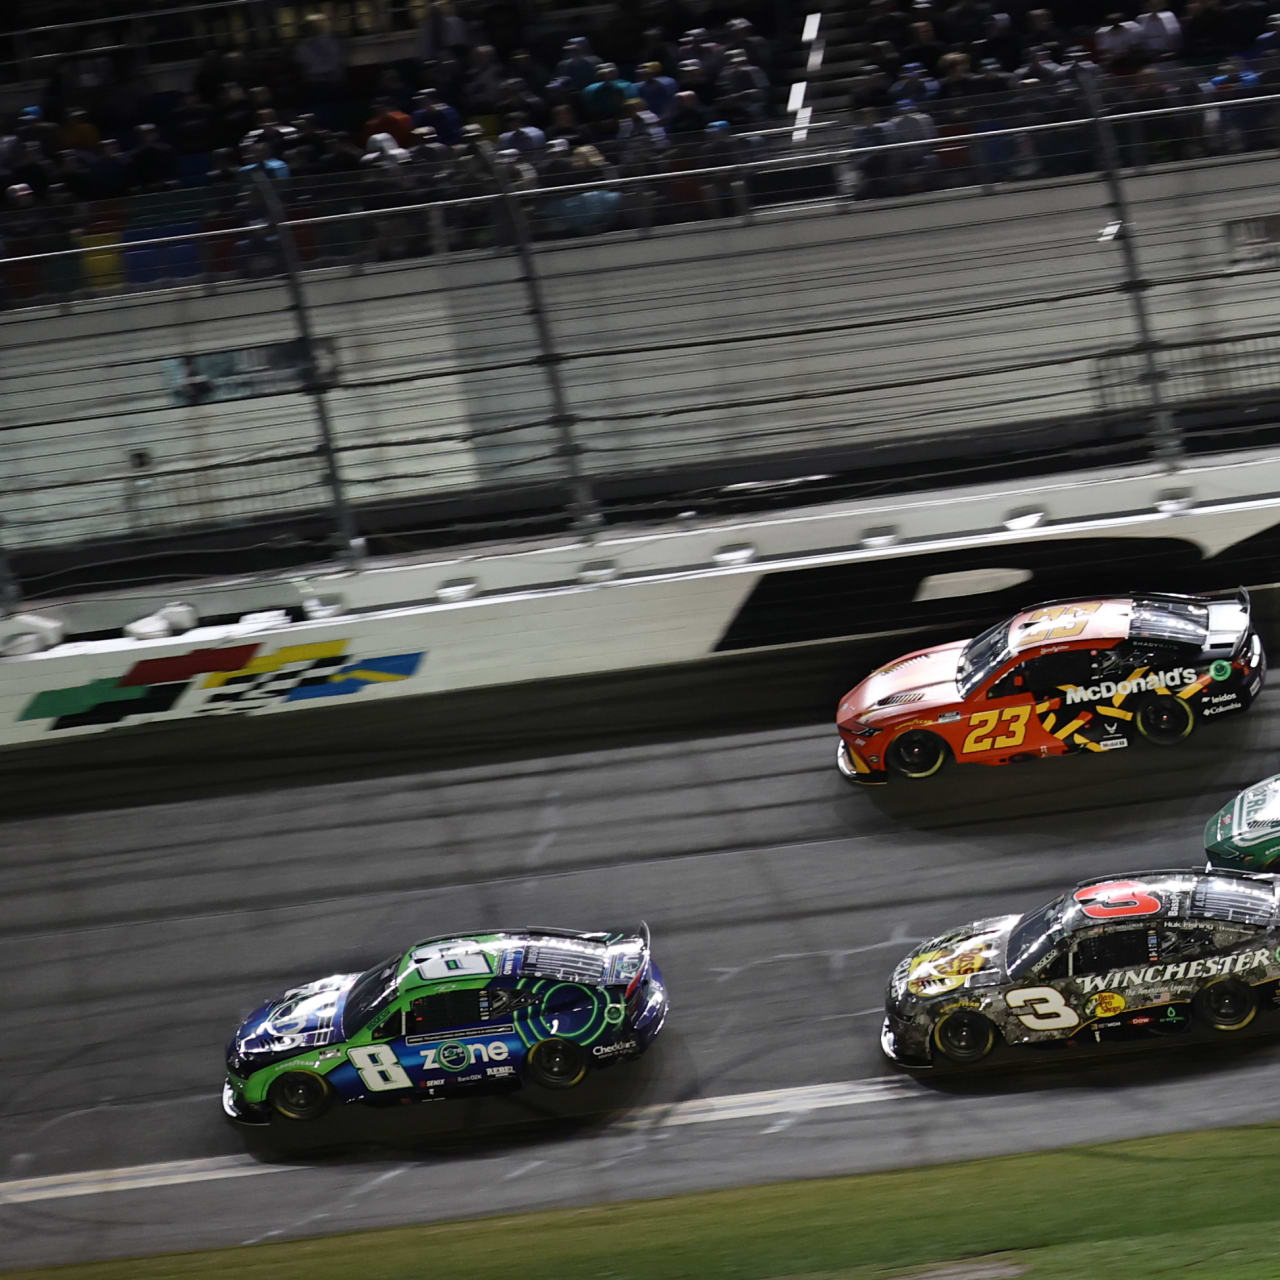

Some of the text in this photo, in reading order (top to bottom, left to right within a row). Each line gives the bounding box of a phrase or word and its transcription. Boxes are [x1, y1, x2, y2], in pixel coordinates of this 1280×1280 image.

[1066, 667, 1198, 705] McDonald's
[1211, 693, 1237, 704] leidos
[1210, 702, 1242, 714] Columbia
[962, 705, 1032, 754] 23
[1179, 922, 1214, 931] Fishing
[1076, 948, 1271, 995] WINCHESTER
[1125, 988, 1136, 996] The
[1004, 986, 1080, 1031] 3
[592, 1039, 637, 1057] Cheddar's
[347, 1043, 414, 1092] 8
